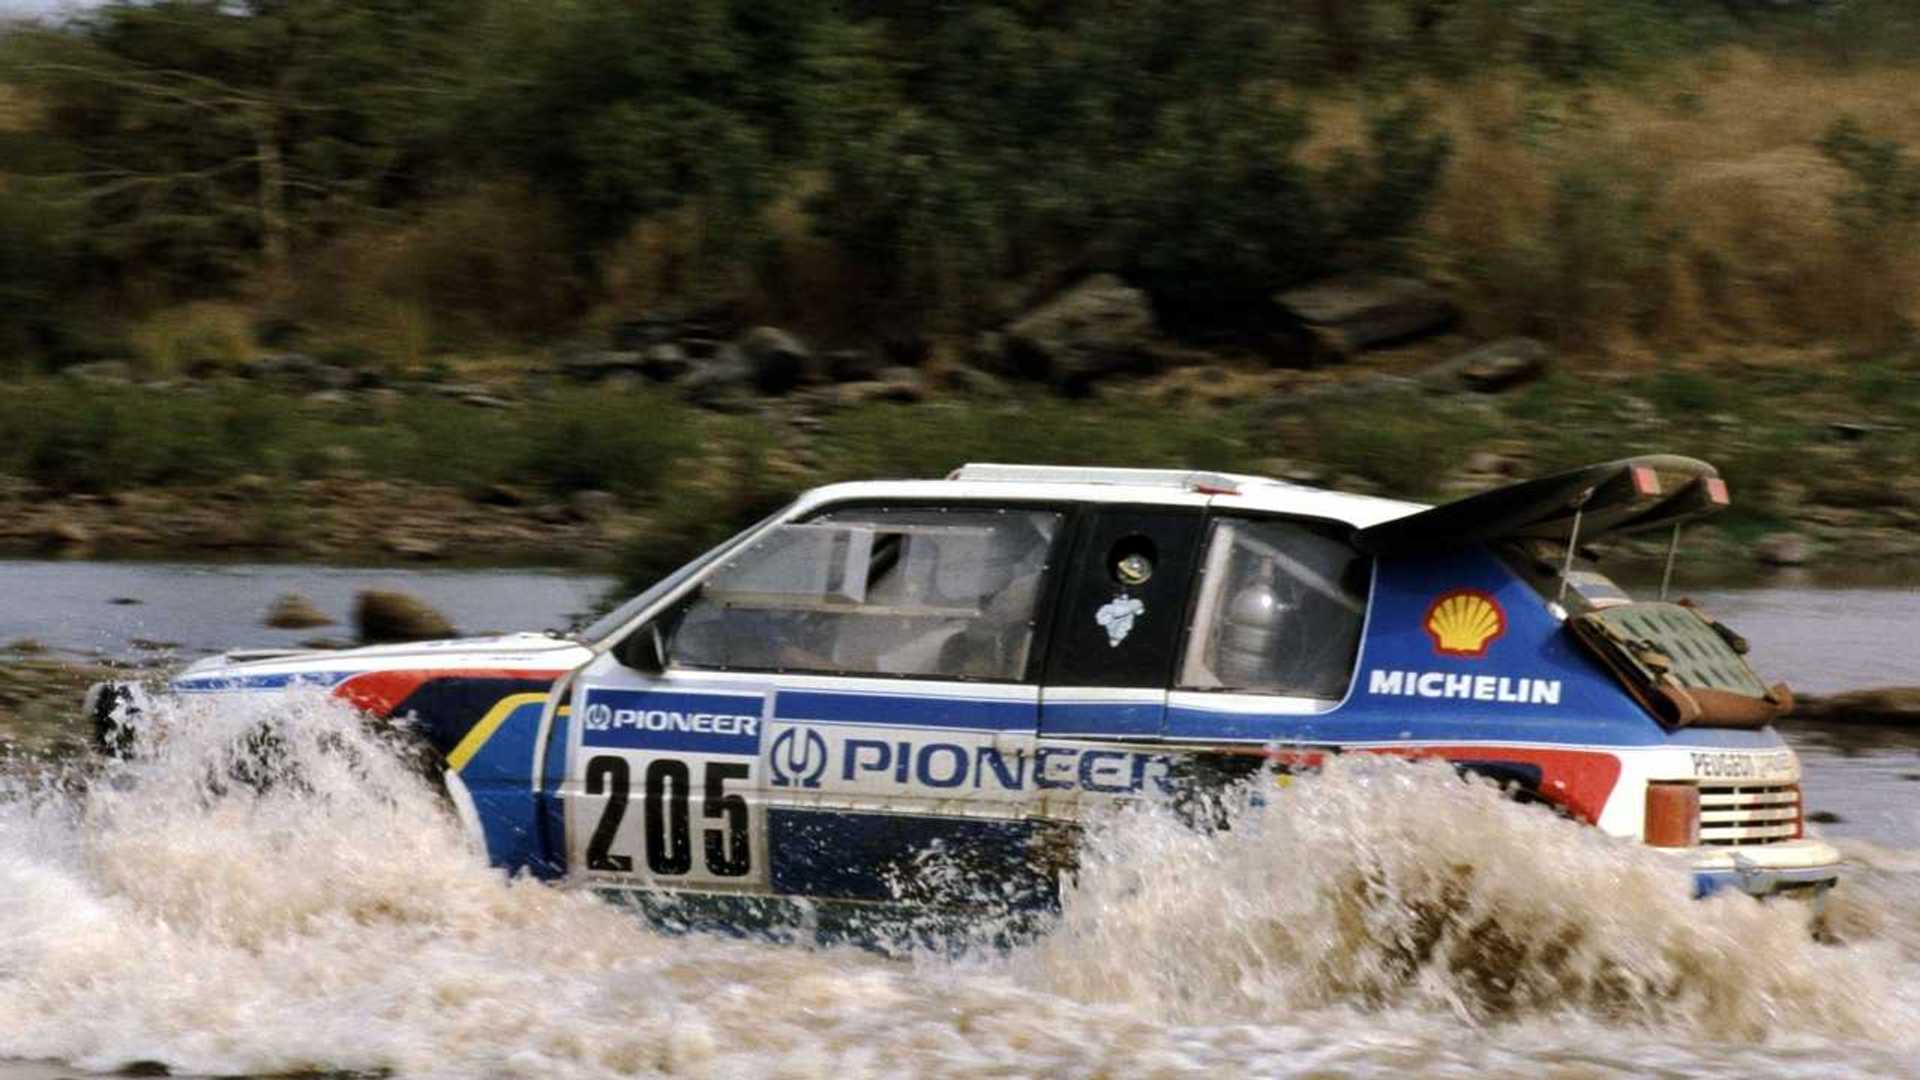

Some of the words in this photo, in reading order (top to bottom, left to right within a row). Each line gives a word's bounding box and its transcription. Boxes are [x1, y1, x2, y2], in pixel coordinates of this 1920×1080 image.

[1368, 669, 1561, 705] MICHELIN
[613, 708, 758, 736] PIONEER
[842, 738, 1175, 793] PIONEER
[585, 755, 750, 876] 205
